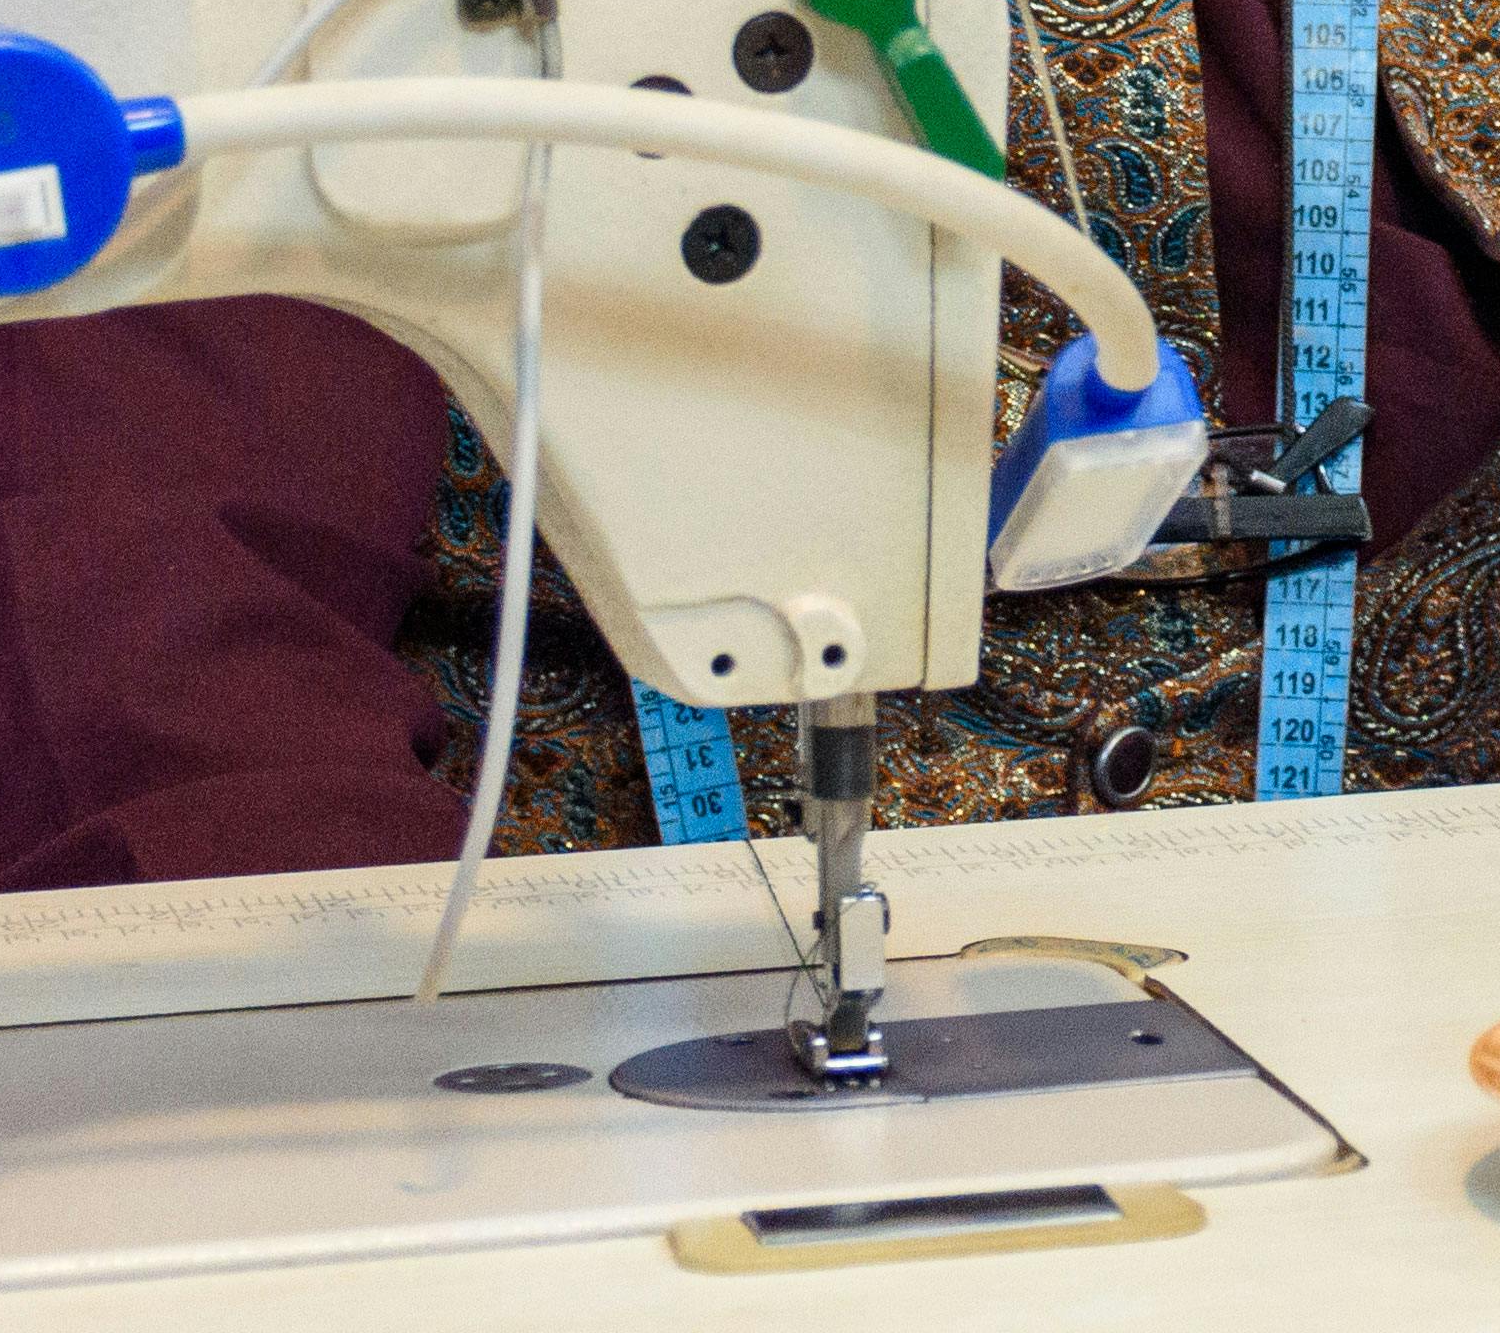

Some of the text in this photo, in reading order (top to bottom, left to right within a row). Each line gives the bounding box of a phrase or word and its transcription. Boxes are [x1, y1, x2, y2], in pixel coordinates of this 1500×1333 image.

[1303, 21, 1347, 47] 105
[1299, 113, 1342, 136] 107
[1297, 158, 1340, 182] 108
[1294, 205, 1338, 229] 109
[1293, 252, 1335, 276] 110
[1294, 298, 1330, 322] 111
[1293, 345, 1331, 370] 112
[1294, 392, 1328, 416] 13
[1275, 625, 1318, 648] 118
[1272, 670, 1317, 695] 119
[1270, 719, 1315, 743] 120
[685, 744, 714, 772] 31
[1269, 766, 1311, 791] 121
[692, 791, 722, 817] 30
